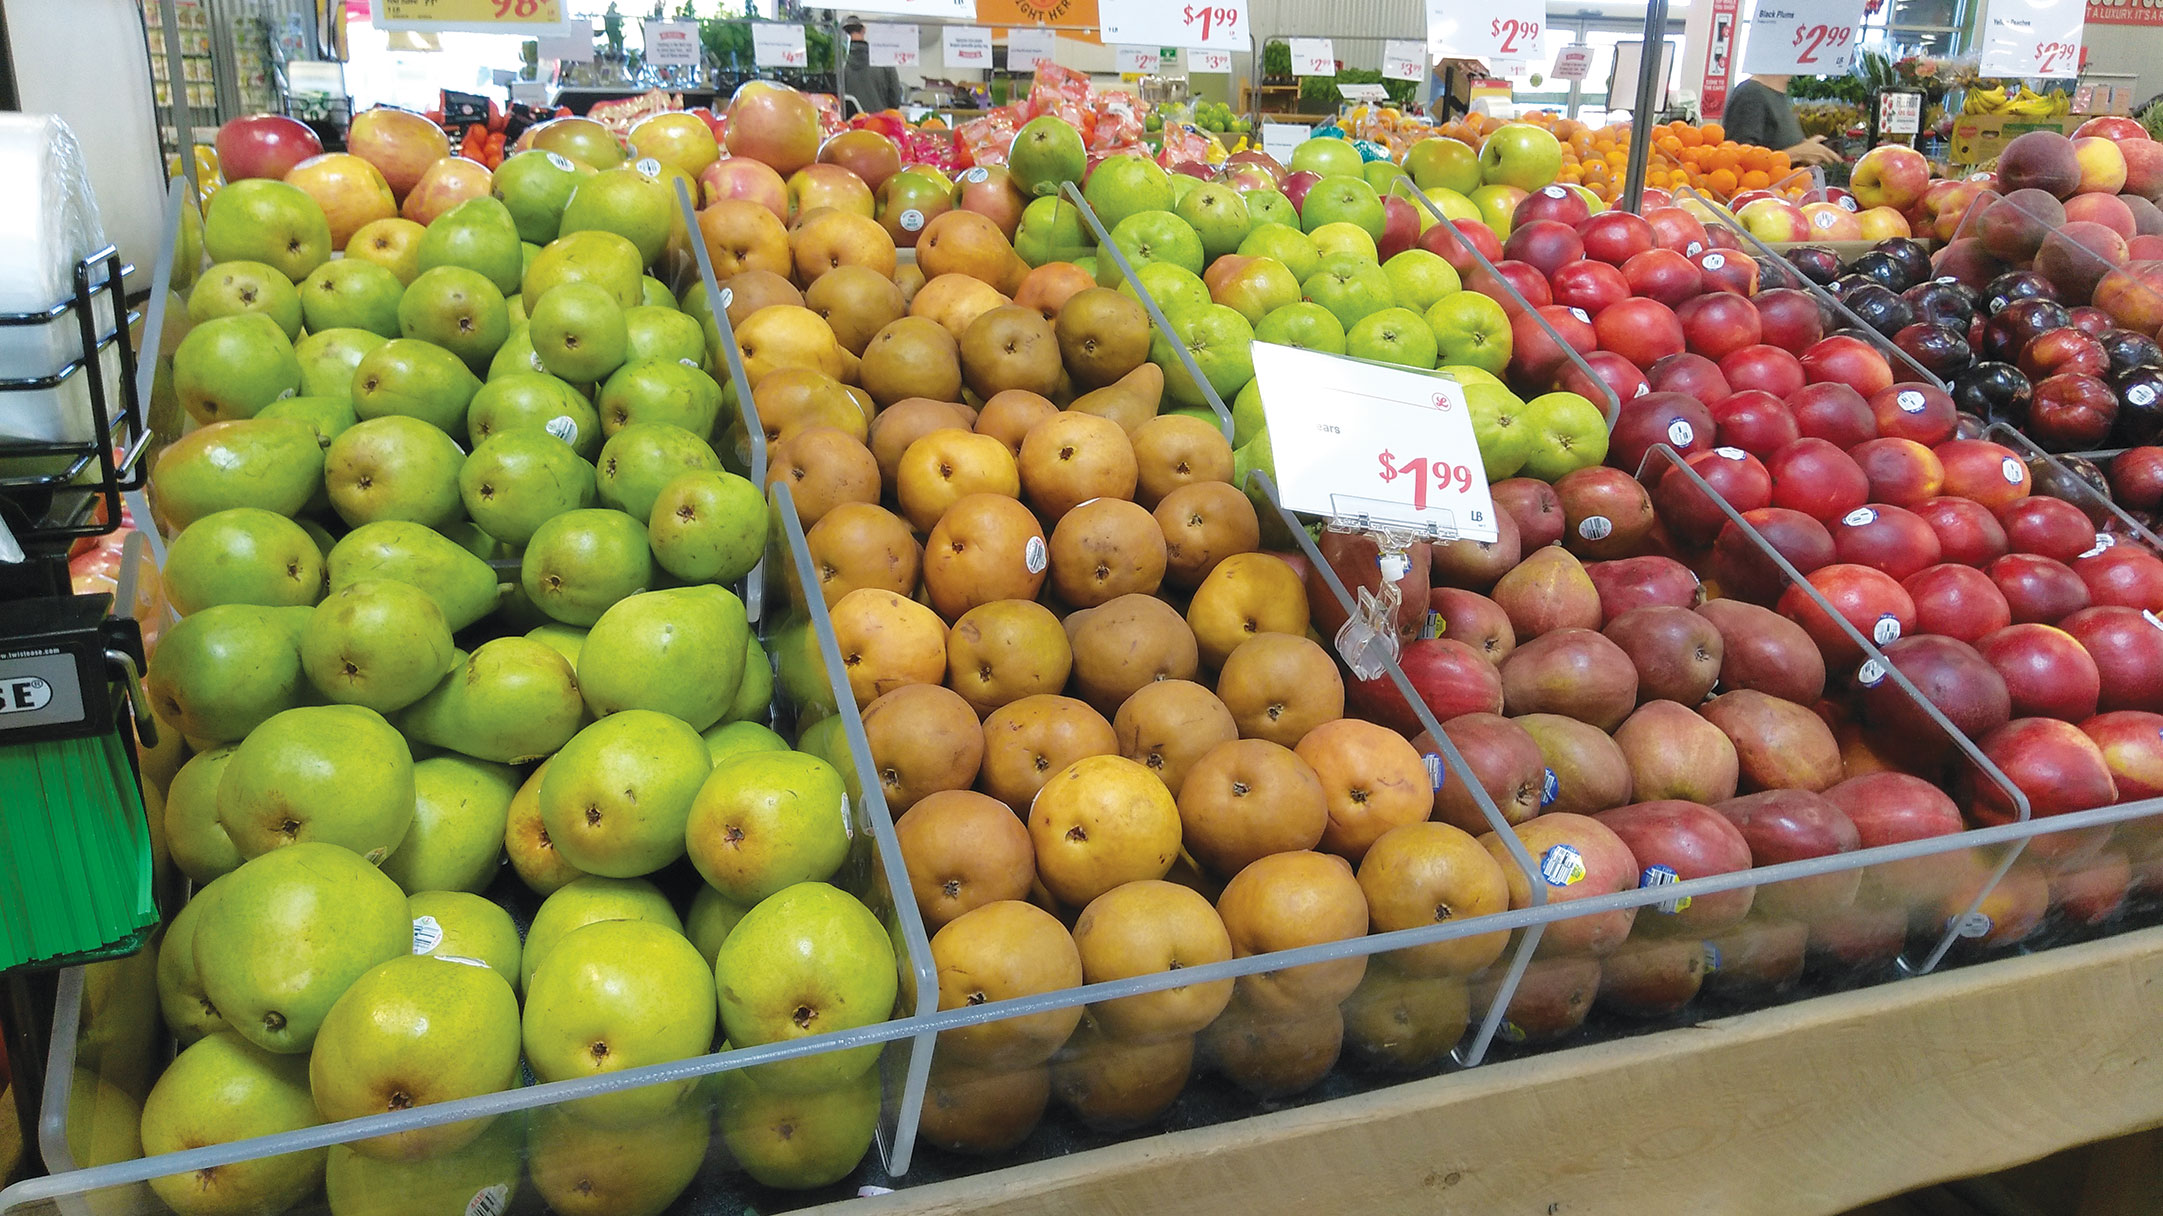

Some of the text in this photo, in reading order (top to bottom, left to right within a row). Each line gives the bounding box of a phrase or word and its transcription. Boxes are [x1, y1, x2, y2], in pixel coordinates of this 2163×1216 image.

[1759, 9, 1794, 19] Black Plums
[2092, 8, 2099, 18] A
[2100, 8, 2133, 20] LUXURY.
[2135, 9, 2151, 21] IT'S
[2151, 10, 2157, 20] A
[1316, 423, 1341, 435] ears
[1471, 511, 1483, 522] LB
